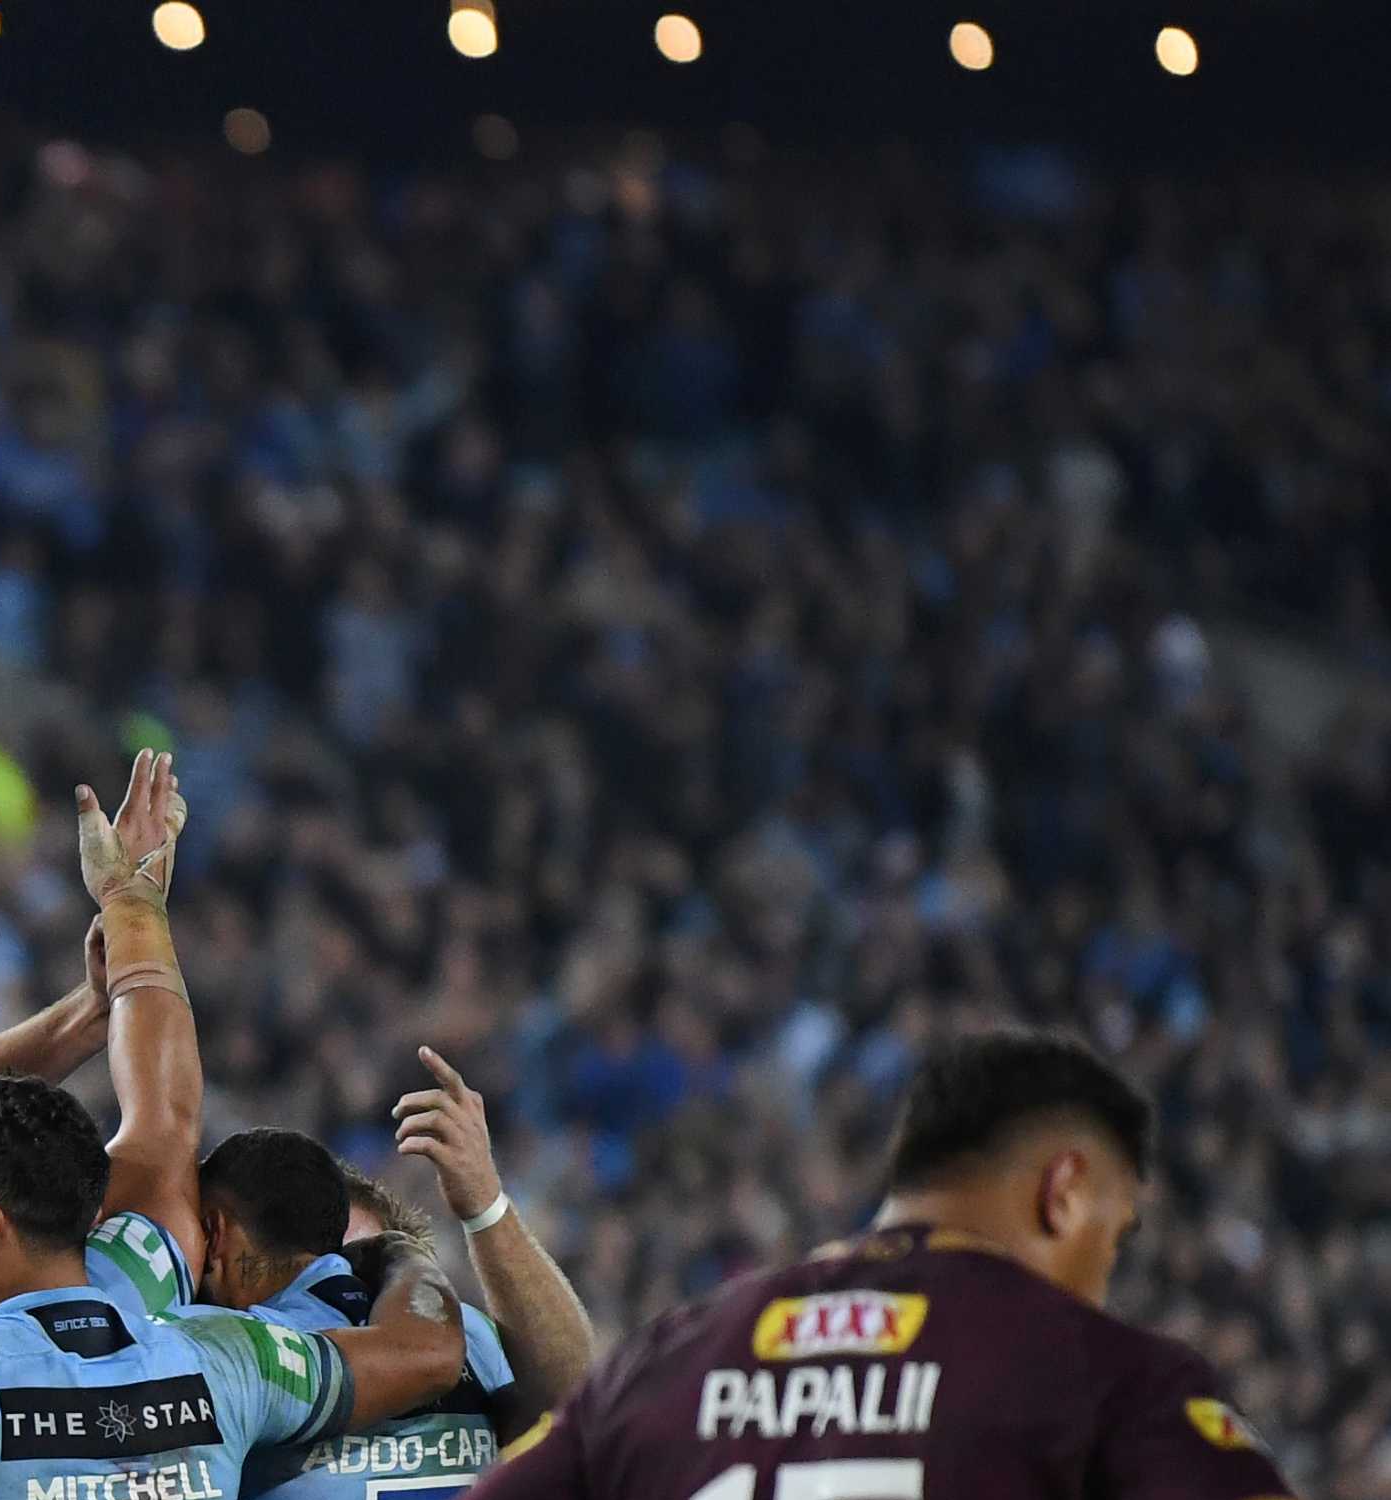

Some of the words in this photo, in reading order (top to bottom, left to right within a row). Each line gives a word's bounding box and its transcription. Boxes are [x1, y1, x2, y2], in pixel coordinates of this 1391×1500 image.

[53, 1317, 88, 1332] SINCE
[6, 1412, 86, 1436] THE
[143, 1398, 214, 1430] STAR
[699, 1361, 941, 1439] PAPALII
[301, 1427, 499, 1475] ADDO-CAR
